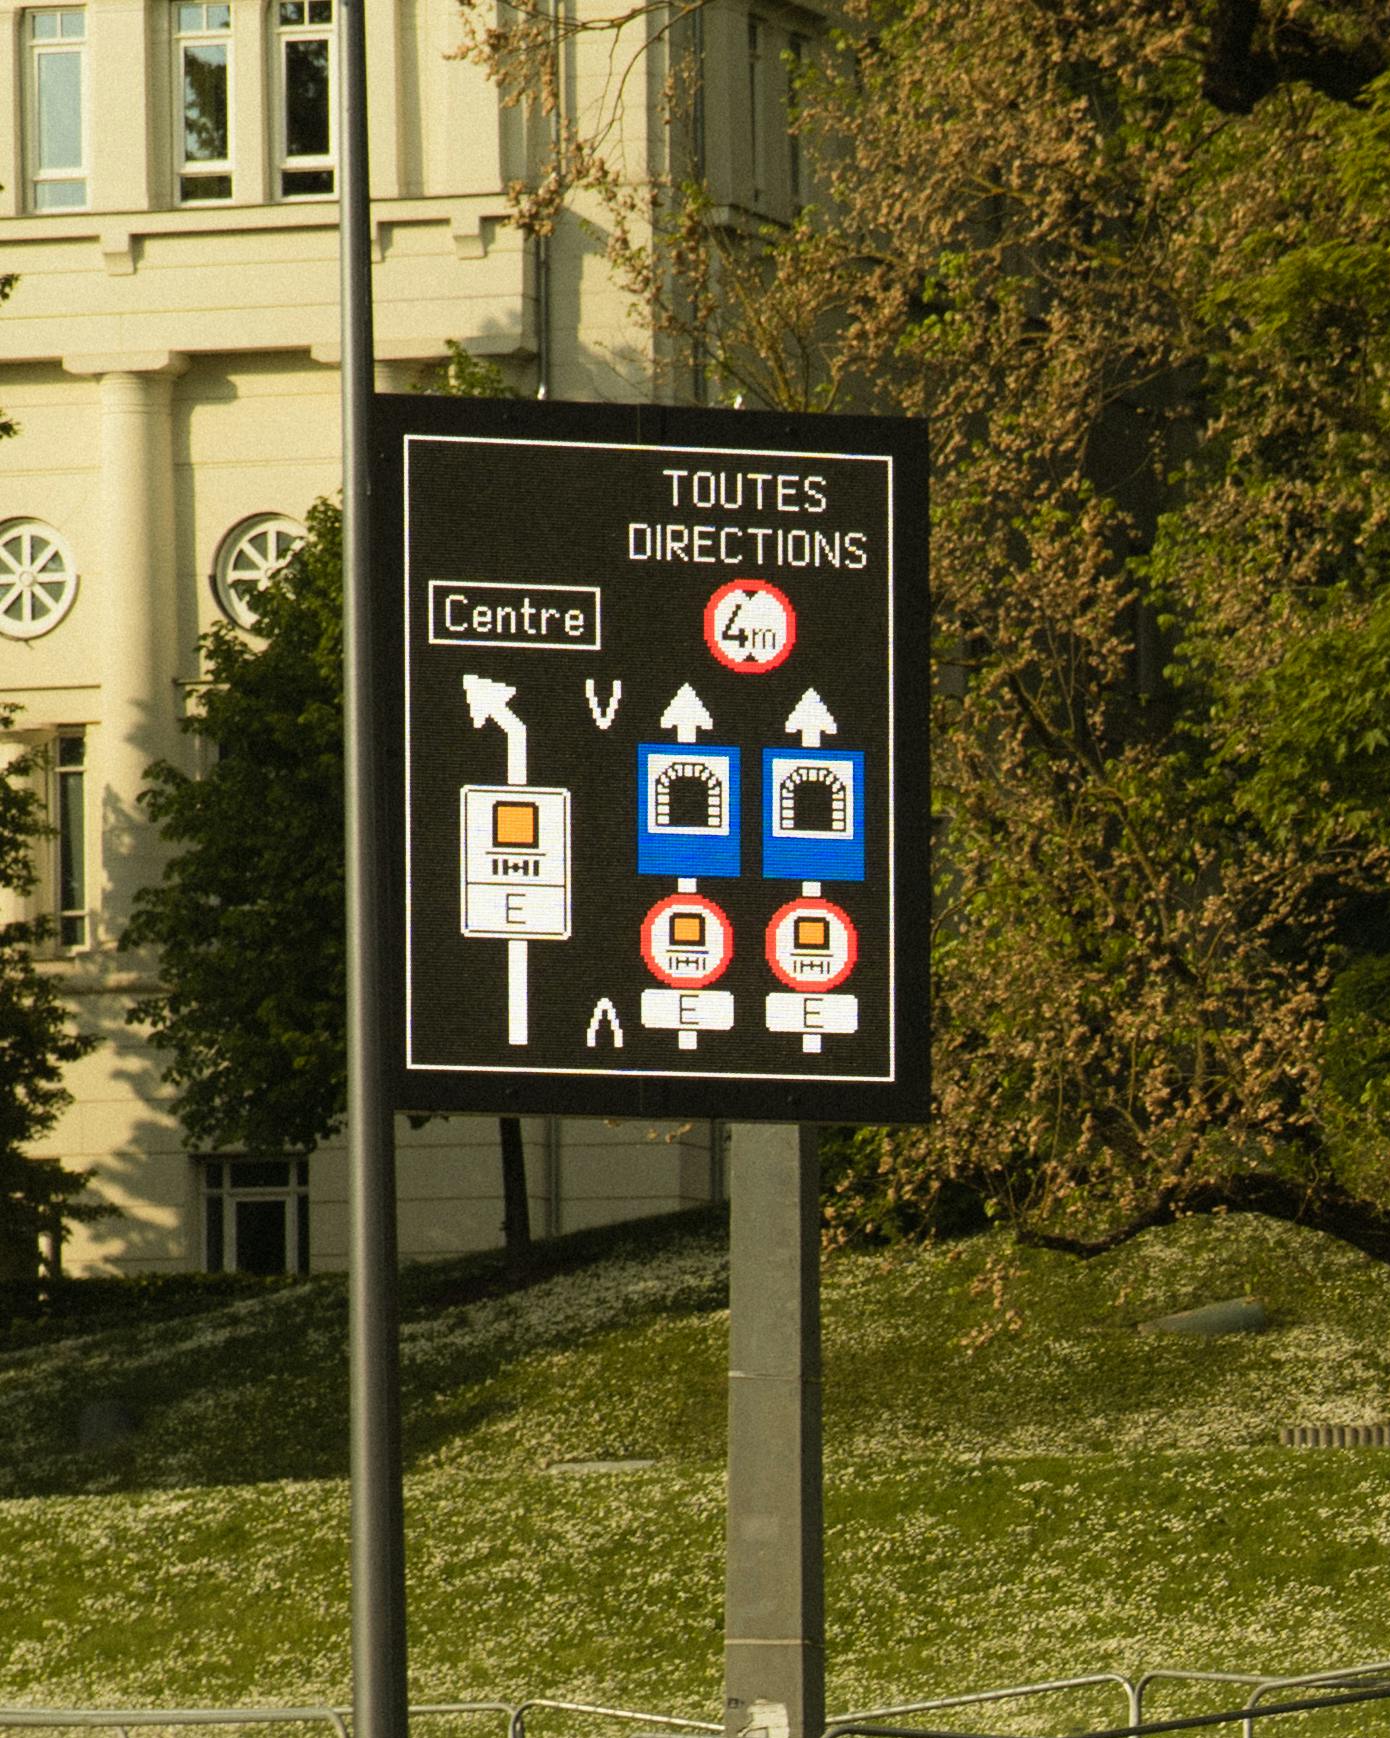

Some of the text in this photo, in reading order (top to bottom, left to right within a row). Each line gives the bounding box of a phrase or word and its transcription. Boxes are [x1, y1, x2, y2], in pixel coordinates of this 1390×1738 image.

[662, 469, 827, 513] TOUTES
[628, 522, 867, 569] DIRECTIONS
[444, 594, 585, 636] Centre
[505, 893, 526, 925] E
[679, 994, 700, 1025] E
[803, 997, 824, 1029] E
